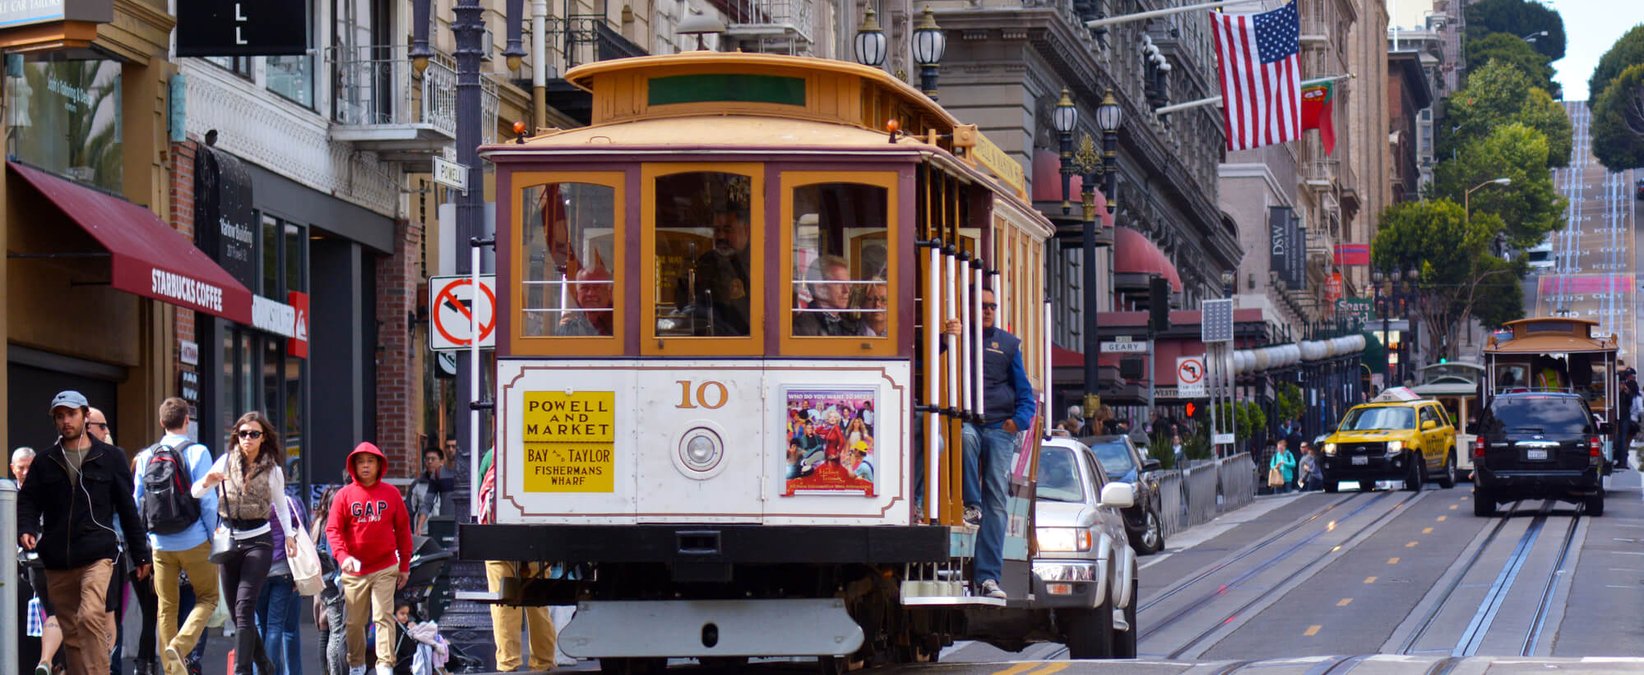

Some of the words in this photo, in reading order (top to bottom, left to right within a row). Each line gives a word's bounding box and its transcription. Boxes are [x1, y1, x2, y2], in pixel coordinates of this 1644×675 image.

[441, 164, 462, 184] POWELL
[1272, 225, 1284, 255] DSW
[151, 267, 196, 304] STARBUCKS
[195, 281, 223, 312] COFFEE
[1338, 300, 1370, 311] Sears
[1108, 343, 1139, 351] GEARY
[674, 380, 729, 410] 10
[529, 401, 608, 412] POWELL
[550, 414, 589, 423] AND
[527, 424, 609, 435] MARKET
[528, 449, 548, 462] BAY
[568, 449, 610, 463] TAYLOR
[535, 466, 602, 475] FISHERMANS
[551, 476, 586, 485] WHARF
[351, 500, 388, 518] GAP
